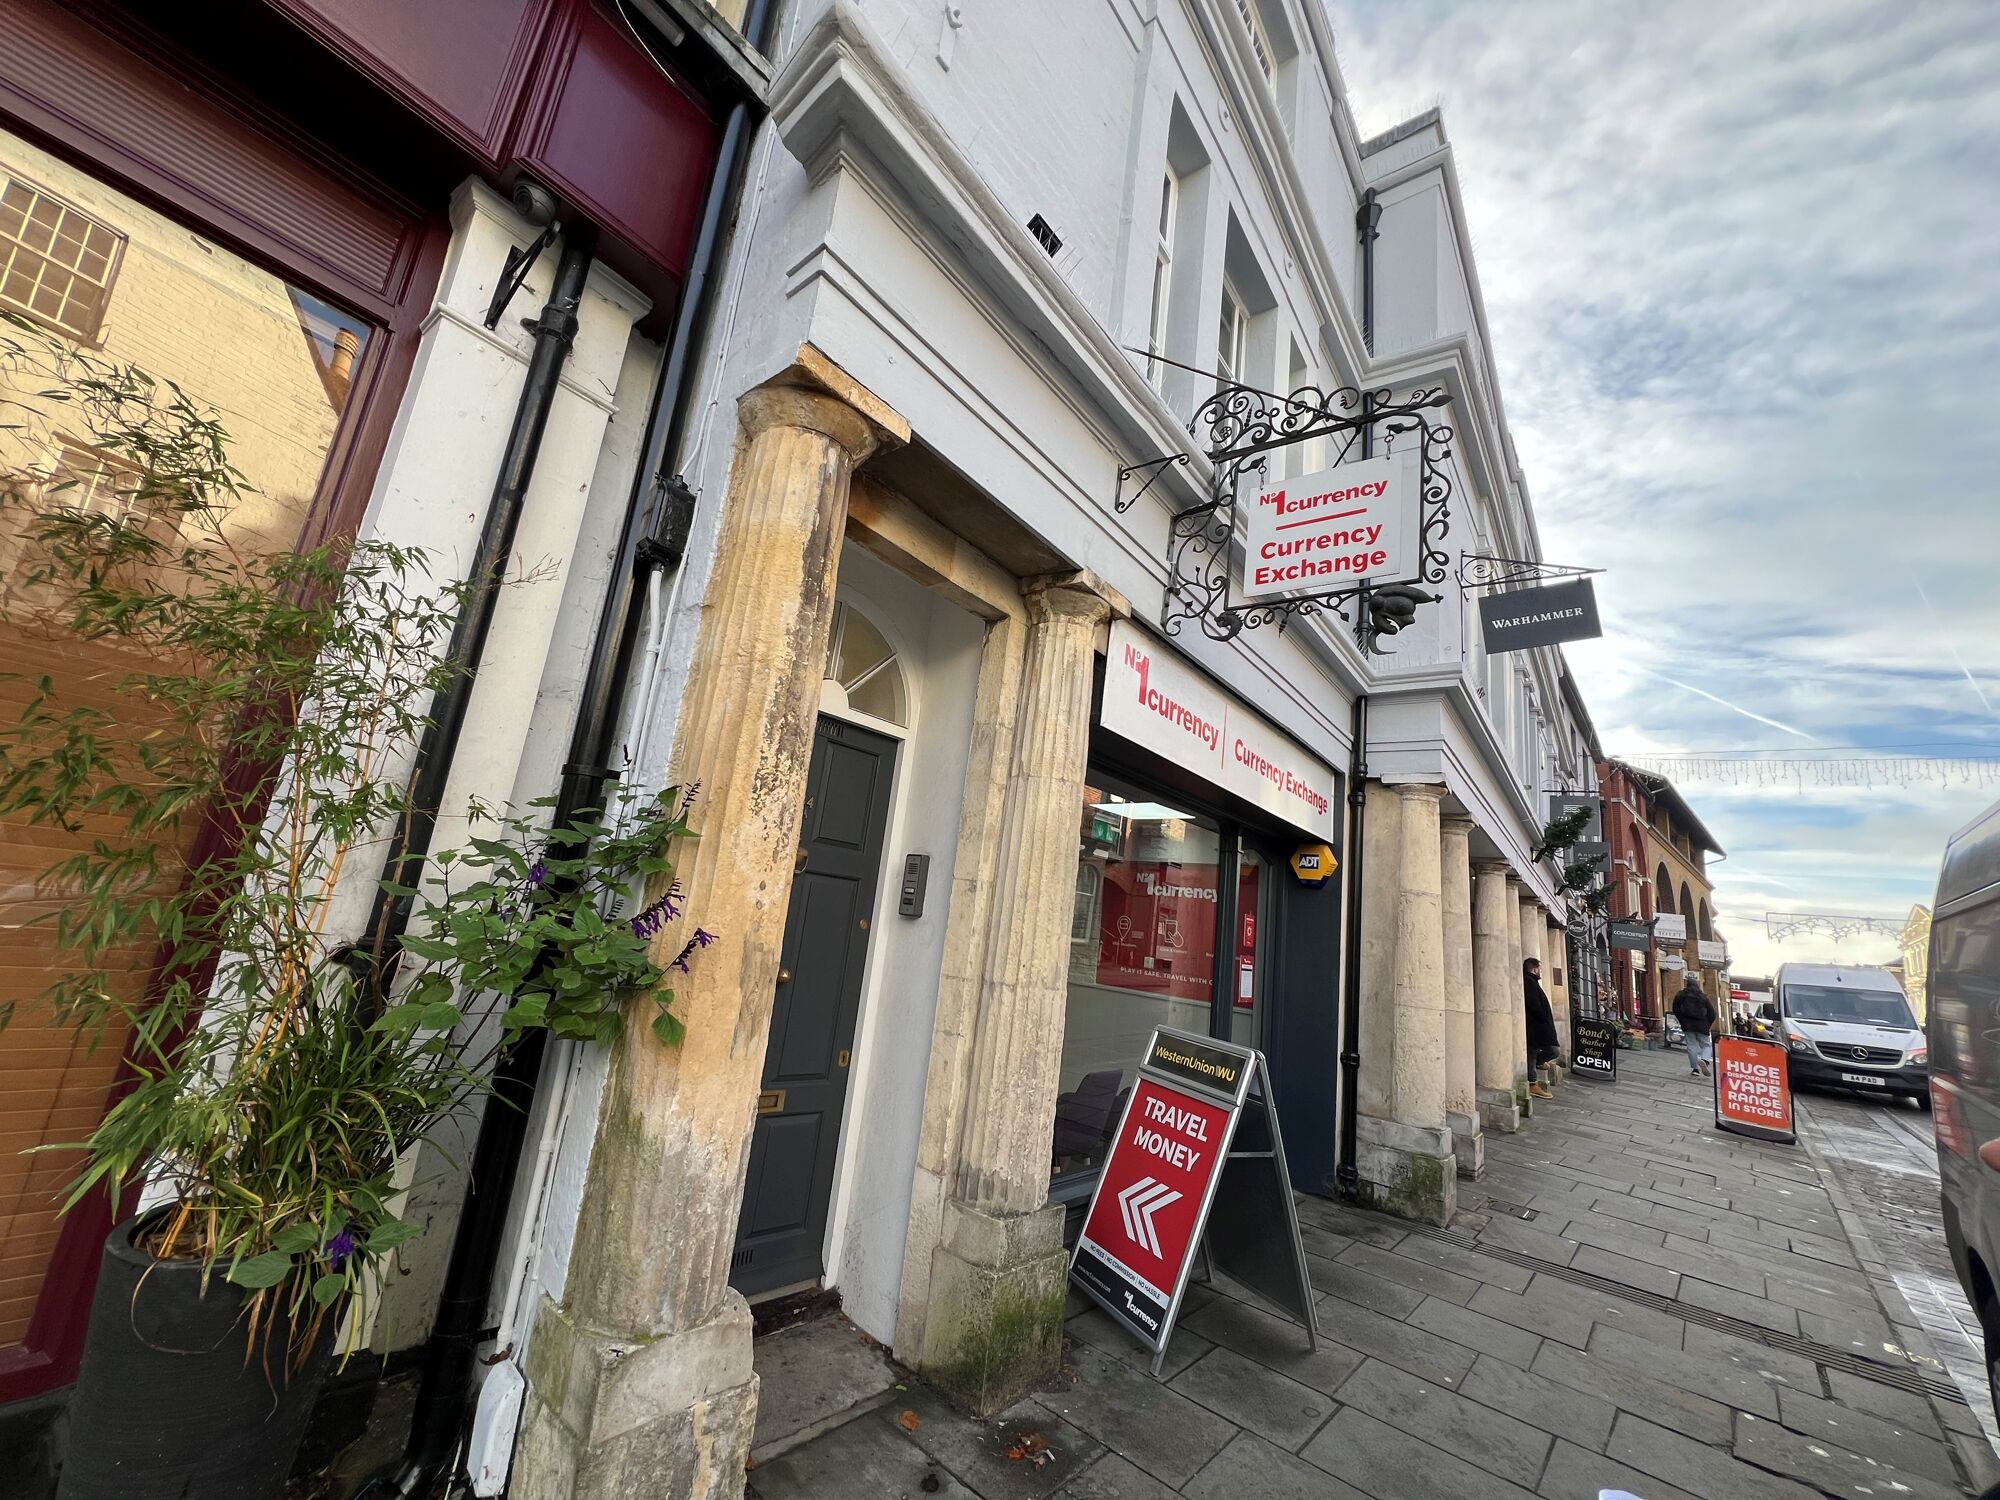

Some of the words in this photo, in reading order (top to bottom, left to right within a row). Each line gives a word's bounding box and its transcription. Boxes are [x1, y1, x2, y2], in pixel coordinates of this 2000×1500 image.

[1261, 524, 1383, 560] Currency
[1255, 550, 1387, 586] Exchange
[1492, 607, 1584, 629] WARHAMMER
[1234, 738, 1285, 792] Currency
[1285, 771, 1329, 816] Exchange
[1298, 856, 1320, 868] ADT
[1163, 973, 1188, 982] TRAVEL
[1189, 977, 1207, 985] WITH
[1577, 1026, 1611, 1040] Bond's
[1580, 1038, 1606, 1048] Barber
[1577, 1055, 1611, 1070] OPEN
[1583, 1048, 1603, 1058] Shop
[1217, 1065, 1235, 1082] WU
[1726, 1059, 1780, 1080] HUGE
[1727, 1071, 1781, 1086] DISPOSABLES
[1728, 1078, 1781, 1099] VAPE
[1728, 1090, 1782, 1110] RANGE
[1144, 1096, 1208, 1142] TRAVEL
[1728, 1102, 1740, 1111] IN
[1743, 1104, 1782, 1119] STORE
[1133, 1125, 1201, 1172] MONEY
[1106, 1256, 1113, 1264] NO
[1112, 1259, 1136, 1281] COMMISSION
[1138, 1279, 1145, 1287] NO
[1144, 1284, 1161, 1300] HASSLE
